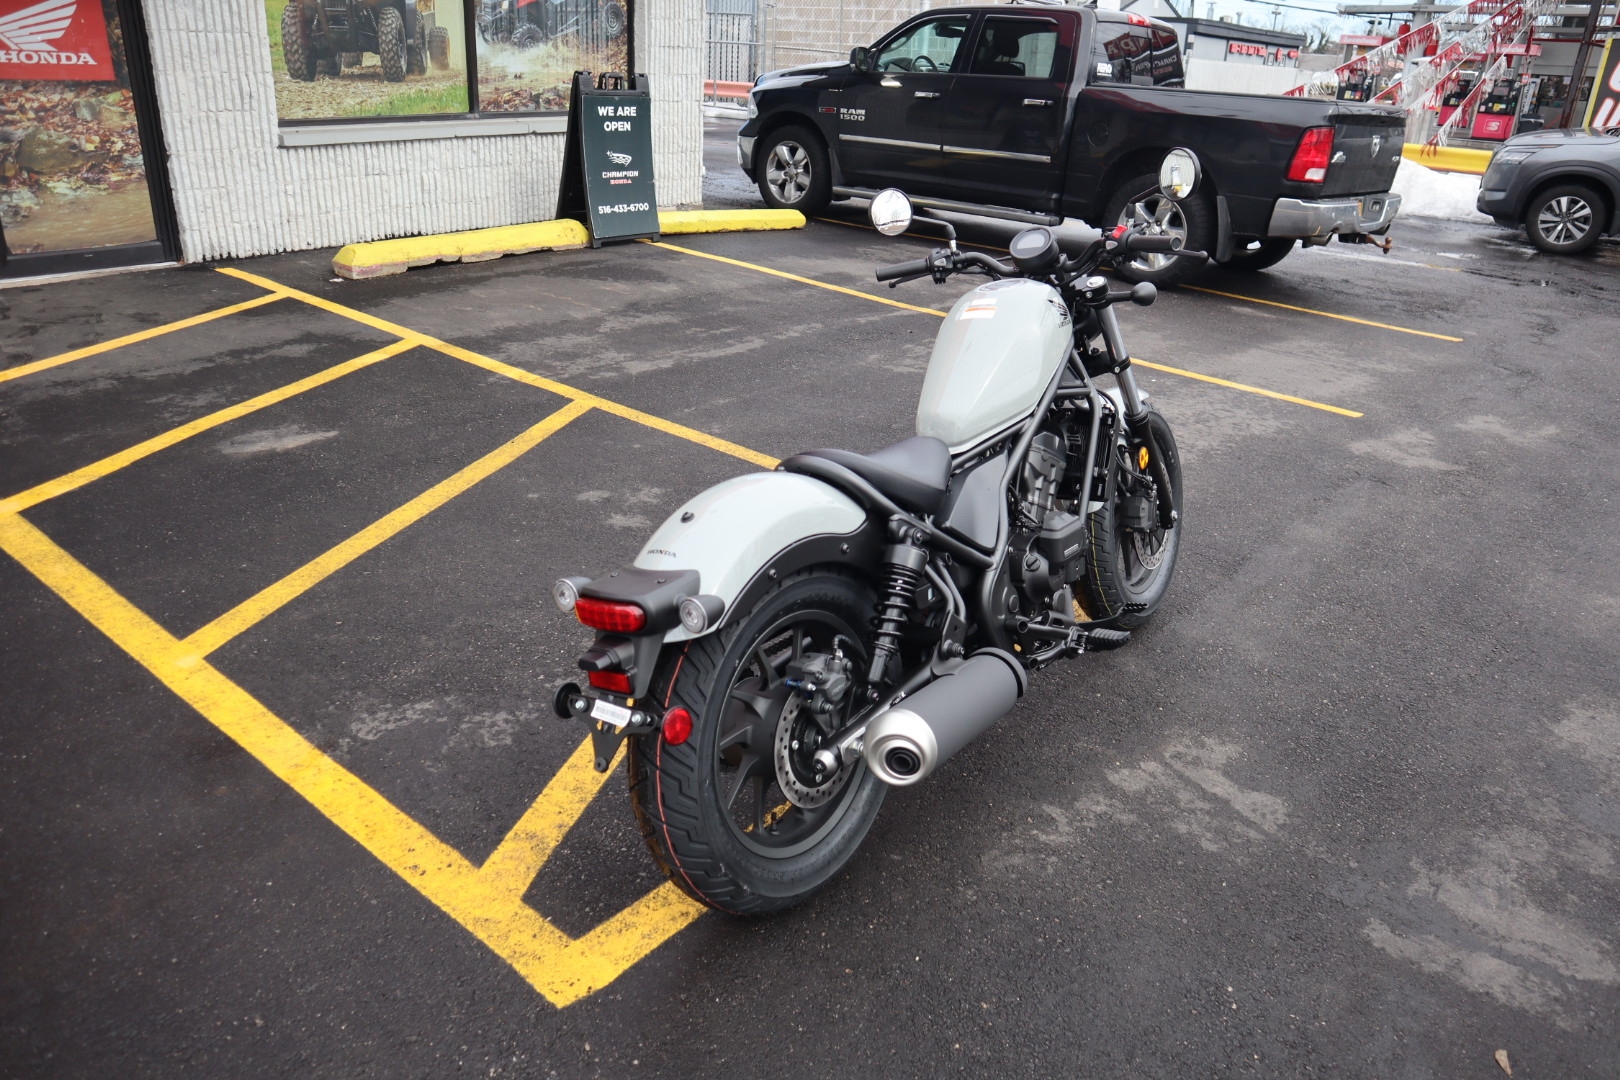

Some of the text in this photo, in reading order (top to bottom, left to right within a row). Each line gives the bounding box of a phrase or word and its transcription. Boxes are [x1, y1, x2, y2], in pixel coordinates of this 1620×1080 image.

[0, 50, 98, 65] HONDA
[597, 106, 637, 117] WE ARE
[603, 121, 631, 132] OPEN
[598, 202, 649, 214] 516-433-6700
[647, 549, 676, 558] HONDA
